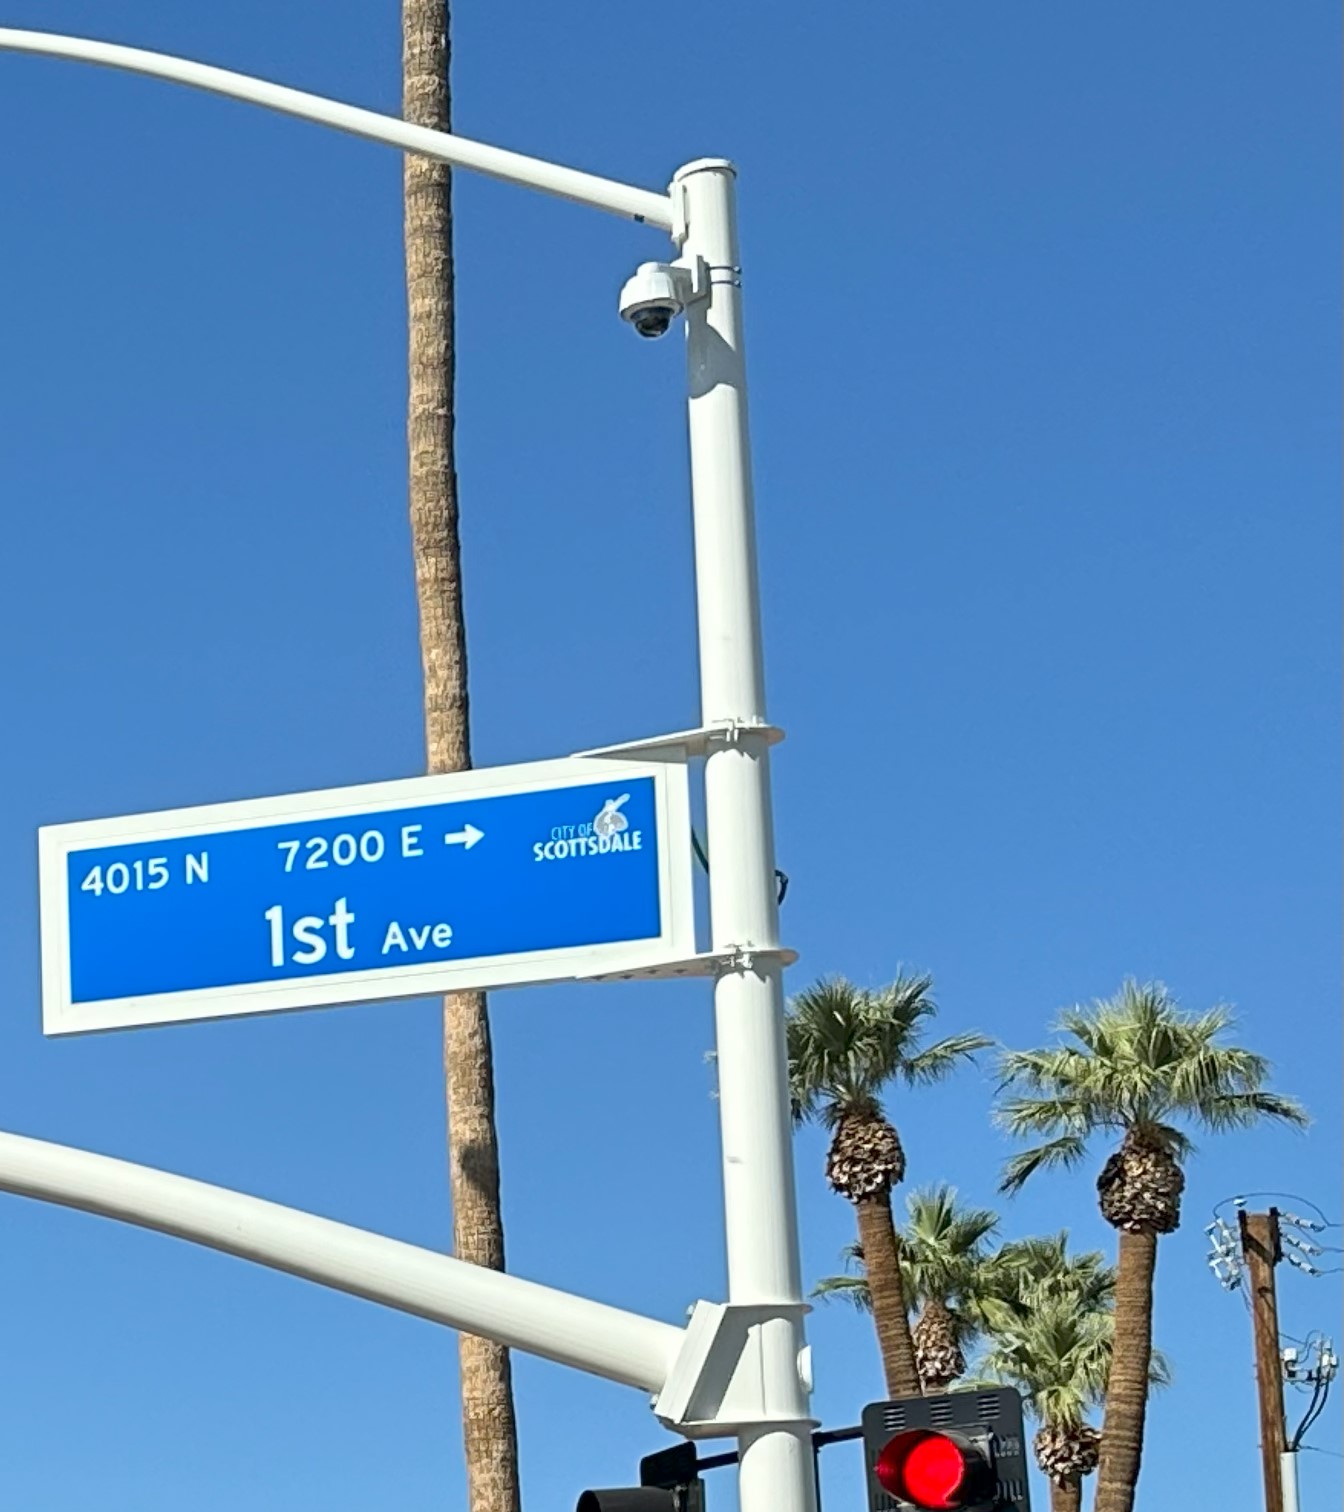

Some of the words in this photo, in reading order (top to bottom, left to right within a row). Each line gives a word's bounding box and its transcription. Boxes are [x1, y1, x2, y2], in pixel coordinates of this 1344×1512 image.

[277, 830, 385, 873] 7200
[401, 824, 424, 858] E
[533, 830, 643, 862] SCOTTSDALE
[551, 825, 575, 841] CITY
[577, 822, 593, 837] OF
[81, 857, 170, 897] 4015
[185, 851, 209, 885] N
[264, 896, 355, 968] 1st
[381, 921, 453, 955] Ave
